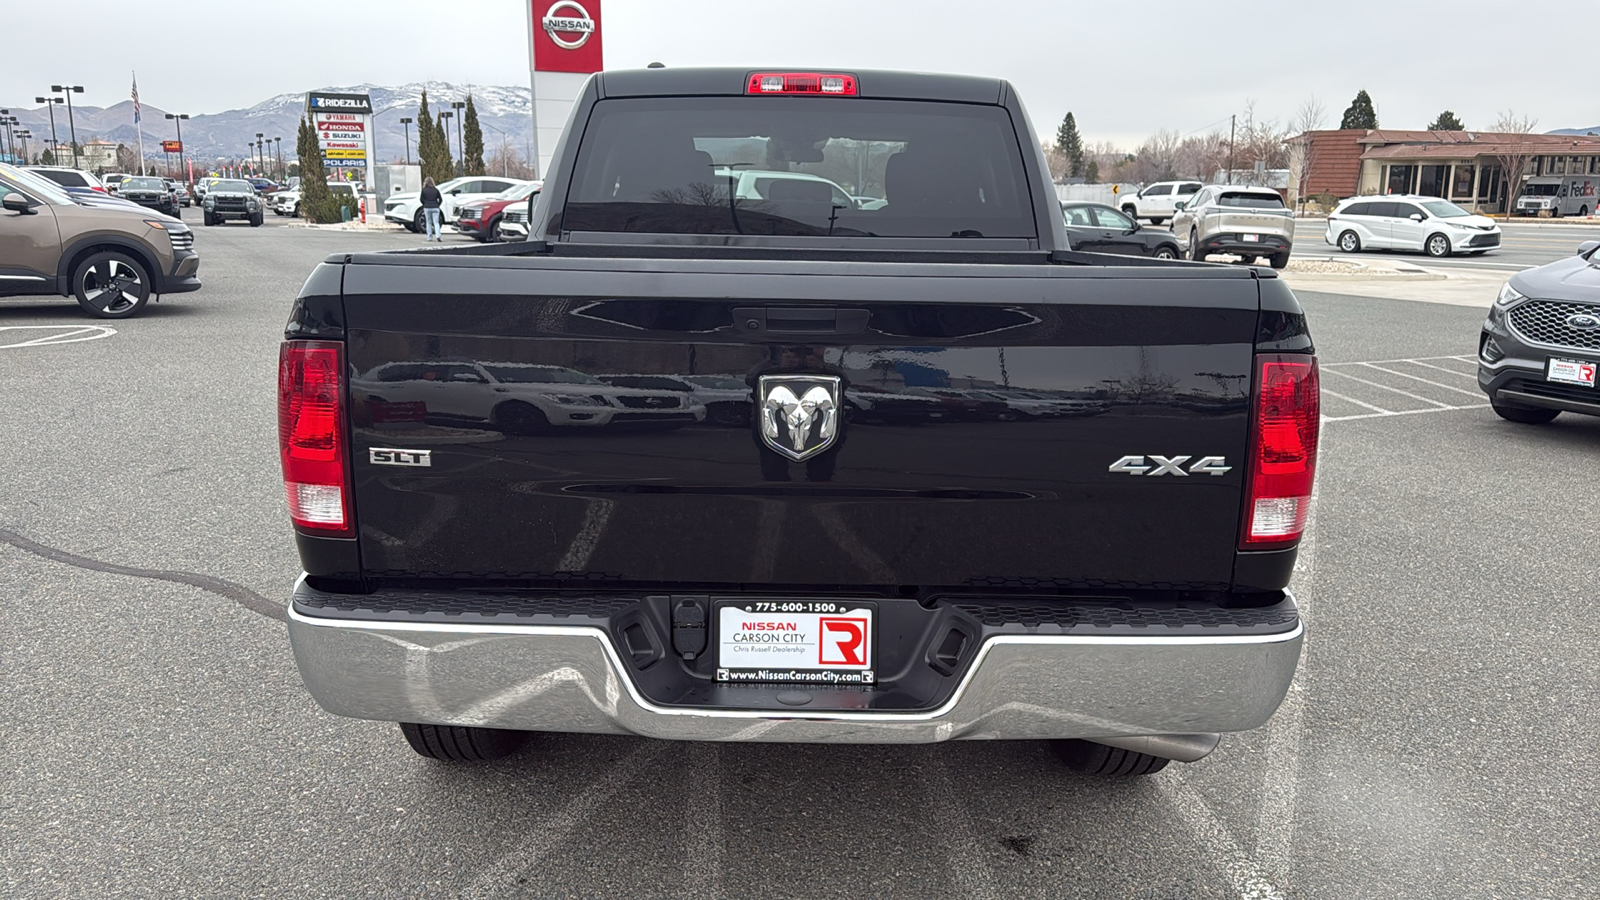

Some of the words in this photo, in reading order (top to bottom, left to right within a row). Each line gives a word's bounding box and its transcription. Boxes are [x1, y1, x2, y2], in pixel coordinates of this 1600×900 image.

[548, 19, 591, 30] NISSAN
[325, 99, 368, 108] RIDEZILLA
[1570, 181, 1595, 196] FedEx
[373, 451, 428, 464] SLT
[756, 603, 836, 613] 775-600-1500
[742, 622, 797, 631] NISSAN
[733, 633, 780, 643] CARSON
[783, 634, 806, 643] CITY
[733, 645, 750, 653] Chris
[773, 646, 805, 654] Dealership
[730, 670, 861, 683] www.NissanCarsonCity.com
